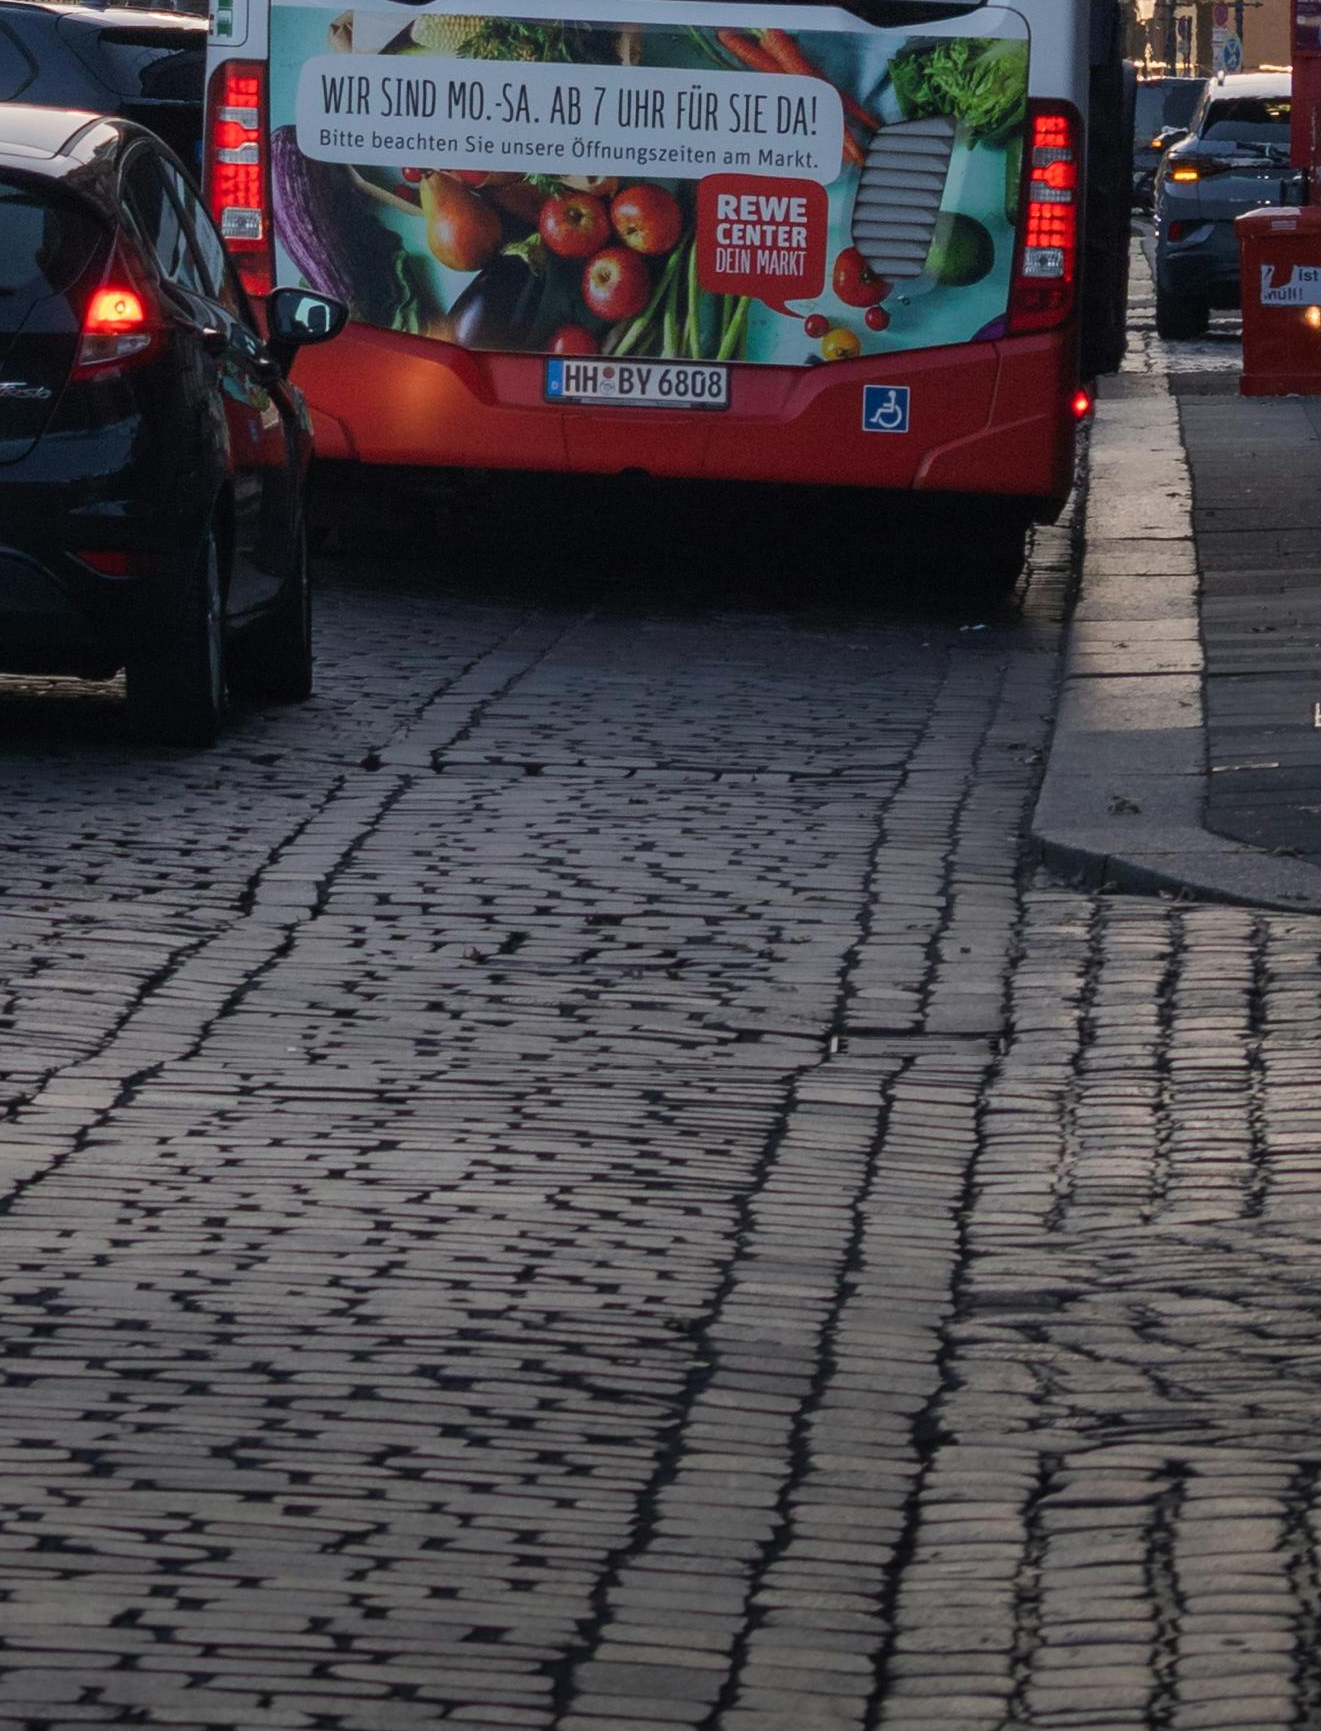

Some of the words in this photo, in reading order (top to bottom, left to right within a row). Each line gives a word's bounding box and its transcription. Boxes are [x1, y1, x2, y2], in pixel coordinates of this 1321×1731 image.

[322, 75, 370, 115] WIR
[381, 77, 436, 118] SIND
[550, 86, 581, 126] AB
[594, 87, 606, 126] 7
[618, 89, 665, 129] UHR
[677, 85, 719, 131] FÜR
[729, 94, 767, 134] SIE
[777, 96, 817, 136] DA!
[320, 129, 364, 148] Bitte
[372, 131, 458, 152] beachten
[465, 136, 495, 154] Sie
[501, 141, 565, 157] unsere
[572, 138, 717, 165] Öffnungszeiten
[723, 150, 751, 165] am
[758, 149, 819, 169] Markt.
[717, 194, 808, 223] REWE
[716, 223, 808, 248] CENTER
[715, 247, 751, 274] DEIN
[756, 249, 808, 276] MARKT
[565, 364, 598, 393] HH
[618, 367, 652, 395] BY
[658, 369, 722, 398] 6808
